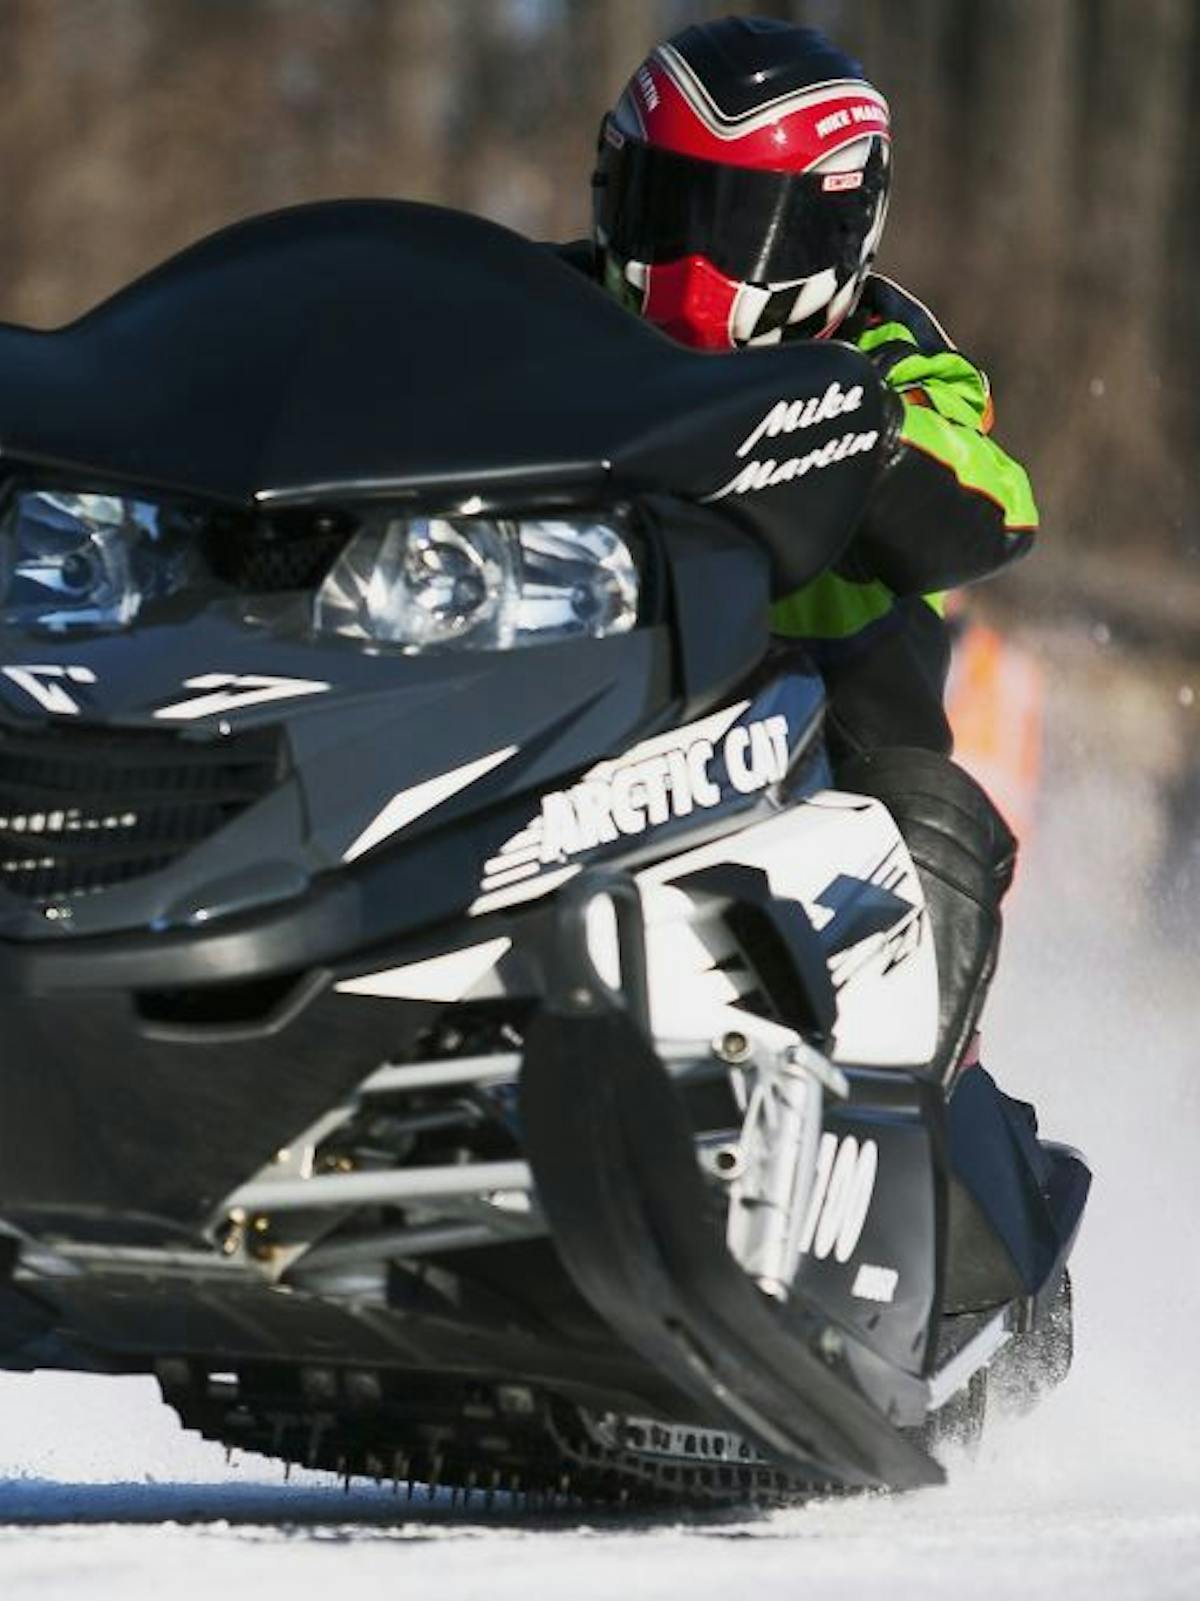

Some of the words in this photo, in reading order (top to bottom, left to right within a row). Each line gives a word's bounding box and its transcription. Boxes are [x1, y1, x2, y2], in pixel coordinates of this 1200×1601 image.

[735, 382, 864, 458] Mike
[702, 430, 879, 503] Martin
[539, 738, 720, 864] ARCTIC
[725, 715, 789, 793] CAT
